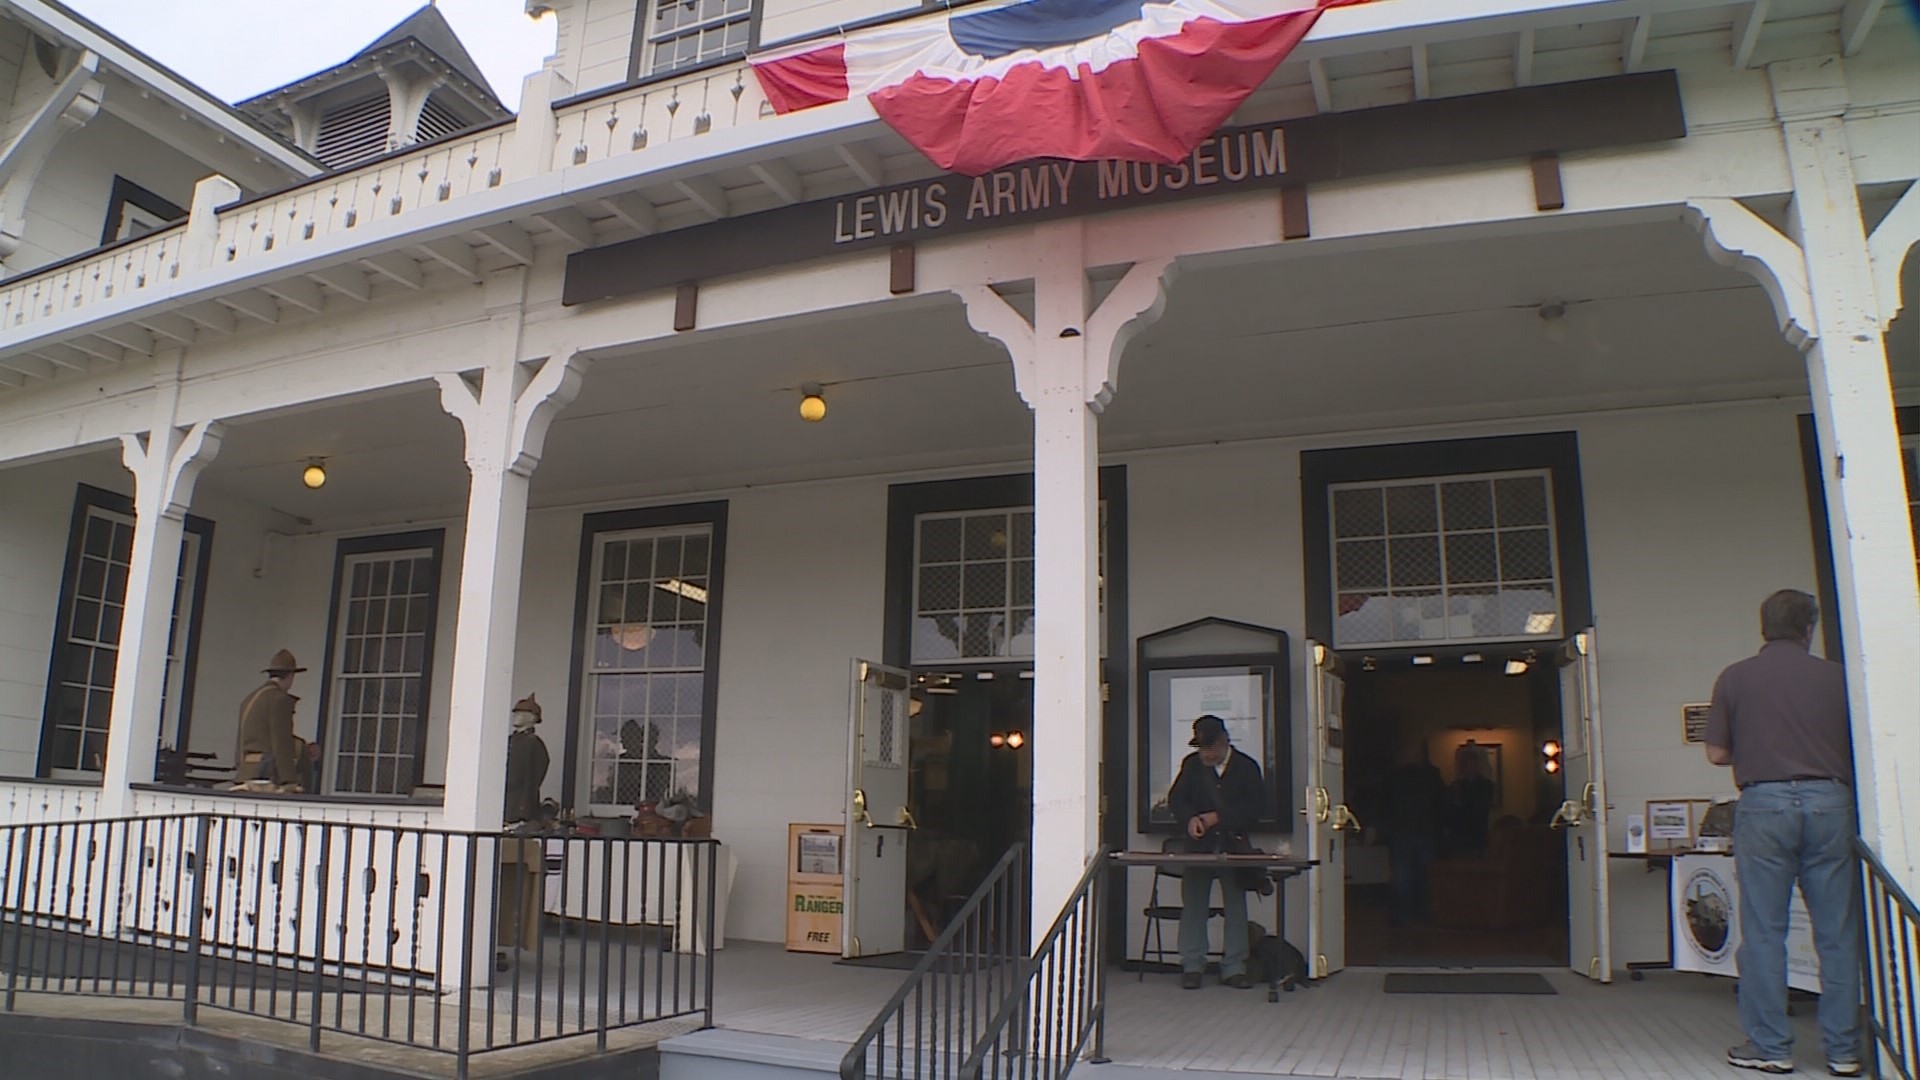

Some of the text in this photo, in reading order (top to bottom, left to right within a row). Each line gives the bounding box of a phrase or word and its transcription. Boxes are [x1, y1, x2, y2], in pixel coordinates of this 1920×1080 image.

[835, 128, 1286, 243] LEWIS ARMY MUSEUM
[794, 894, 844, 914] RANGER
[806, 931, 831, 943] FREE
